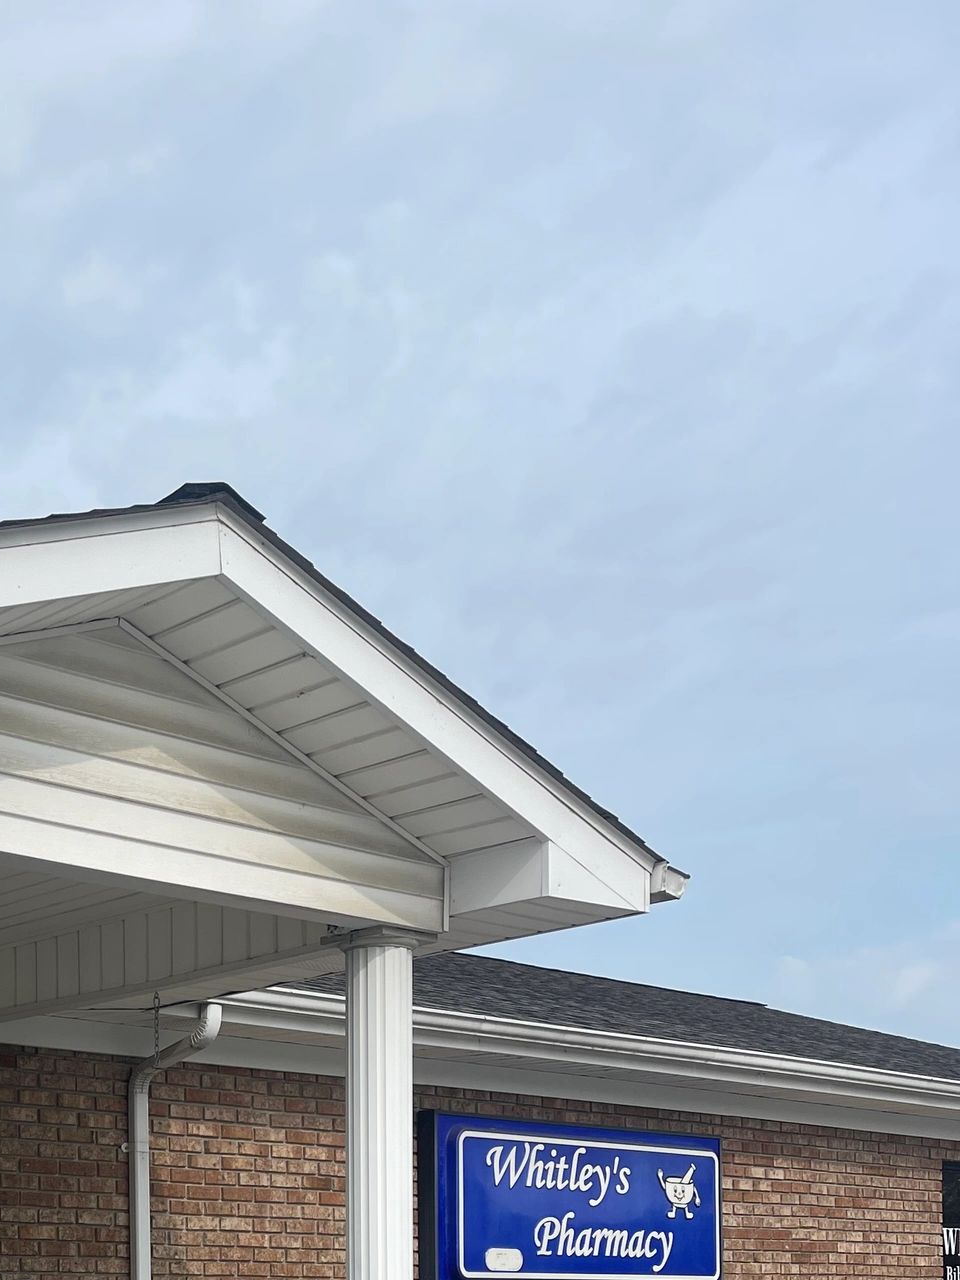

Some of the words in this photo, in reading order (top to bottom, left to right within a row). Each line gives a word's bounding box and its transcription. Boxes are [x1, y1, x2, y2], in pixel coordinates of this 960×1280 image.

[486, 1142, 631, 1207] Whitley's
[534, 1212, 673, 1272] Pharmacy
[942, 1227, 960, 1256] W
